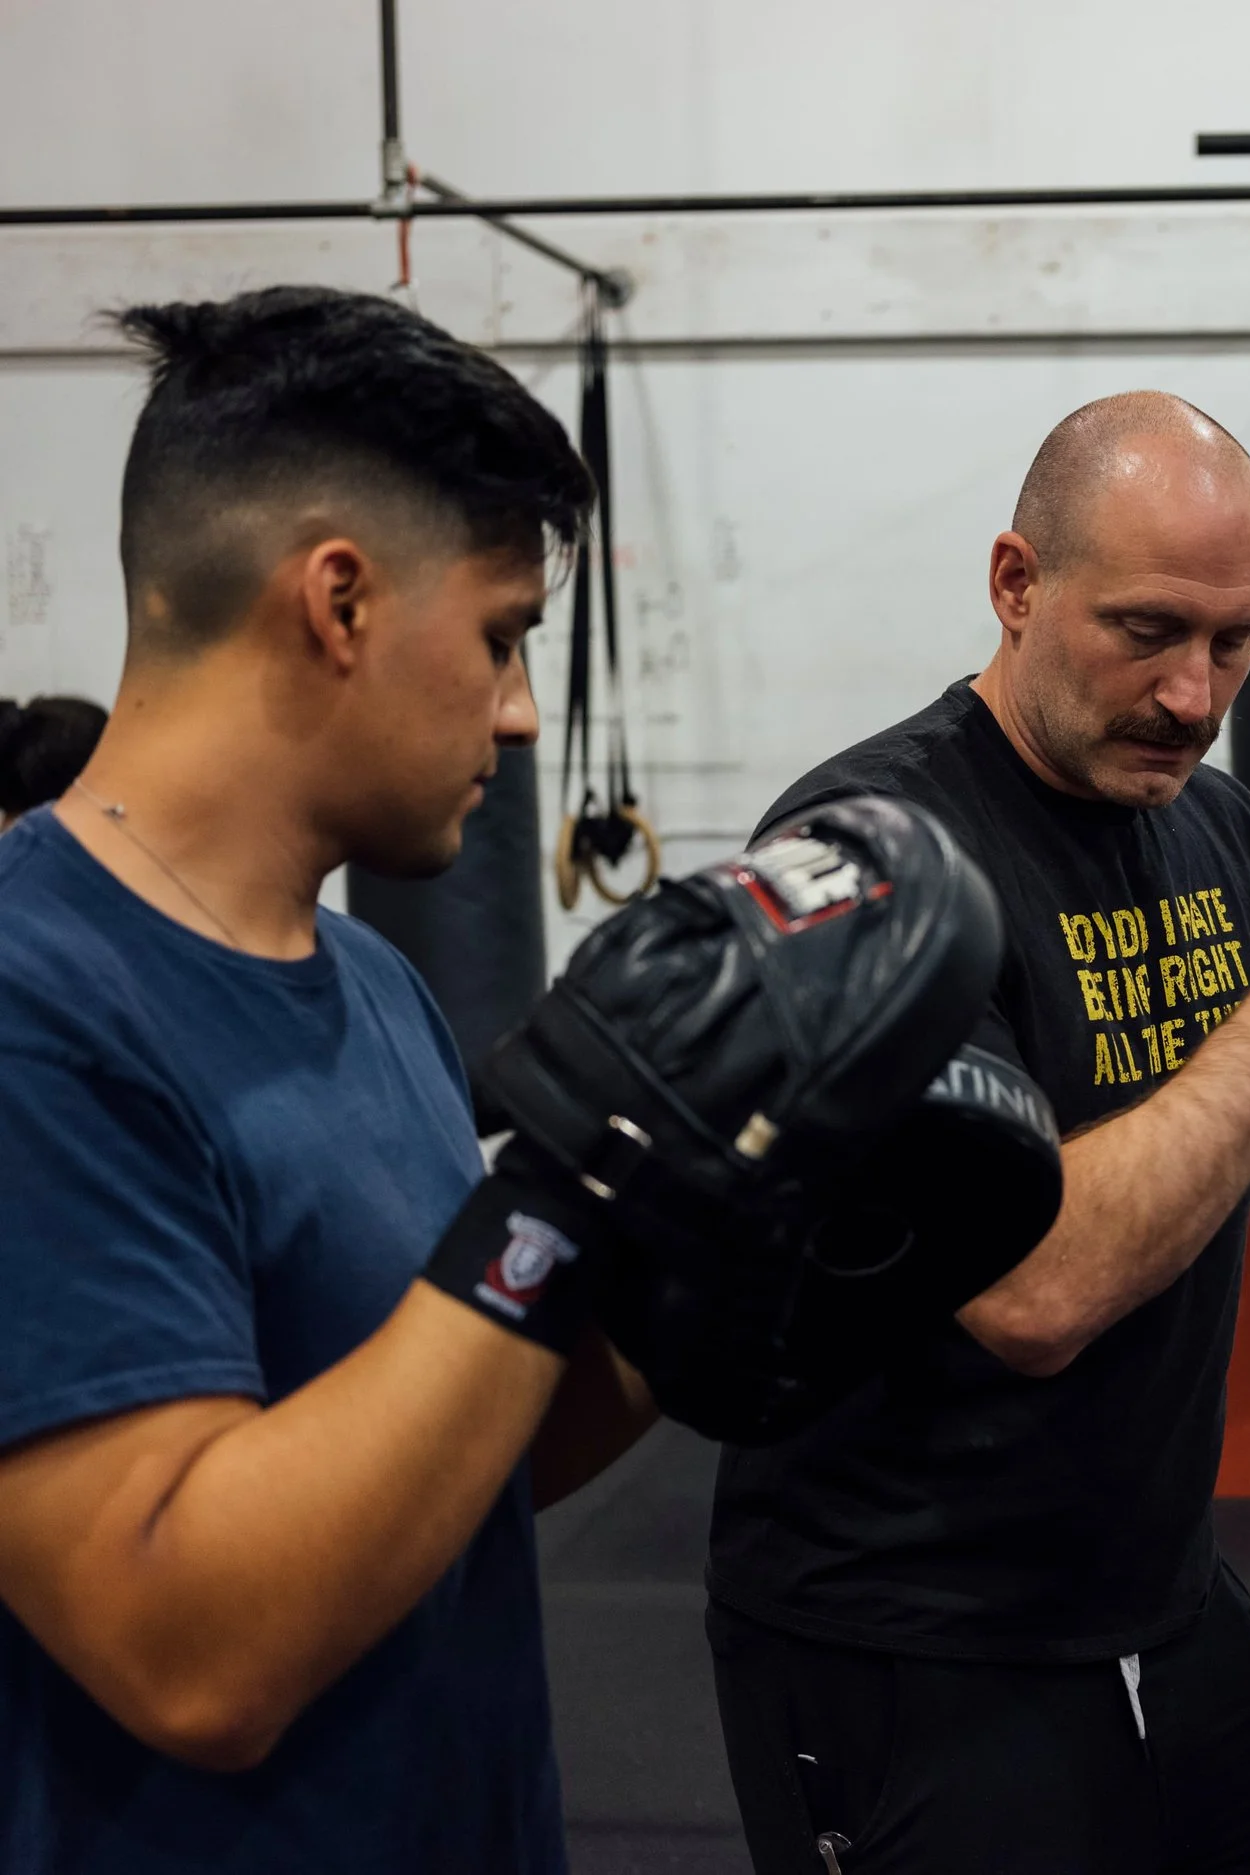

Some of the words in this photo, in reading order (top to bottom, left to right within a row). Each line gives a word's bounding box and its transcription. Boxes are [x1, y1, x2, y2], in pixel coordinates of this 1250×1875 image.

[1160, 899, 1176, 946] I
[1175, 888, 1234, 941] HATE
[1159, 941, 1249, 1007] RIGHT
[1095, 1032, 1142, 1085] ALL
